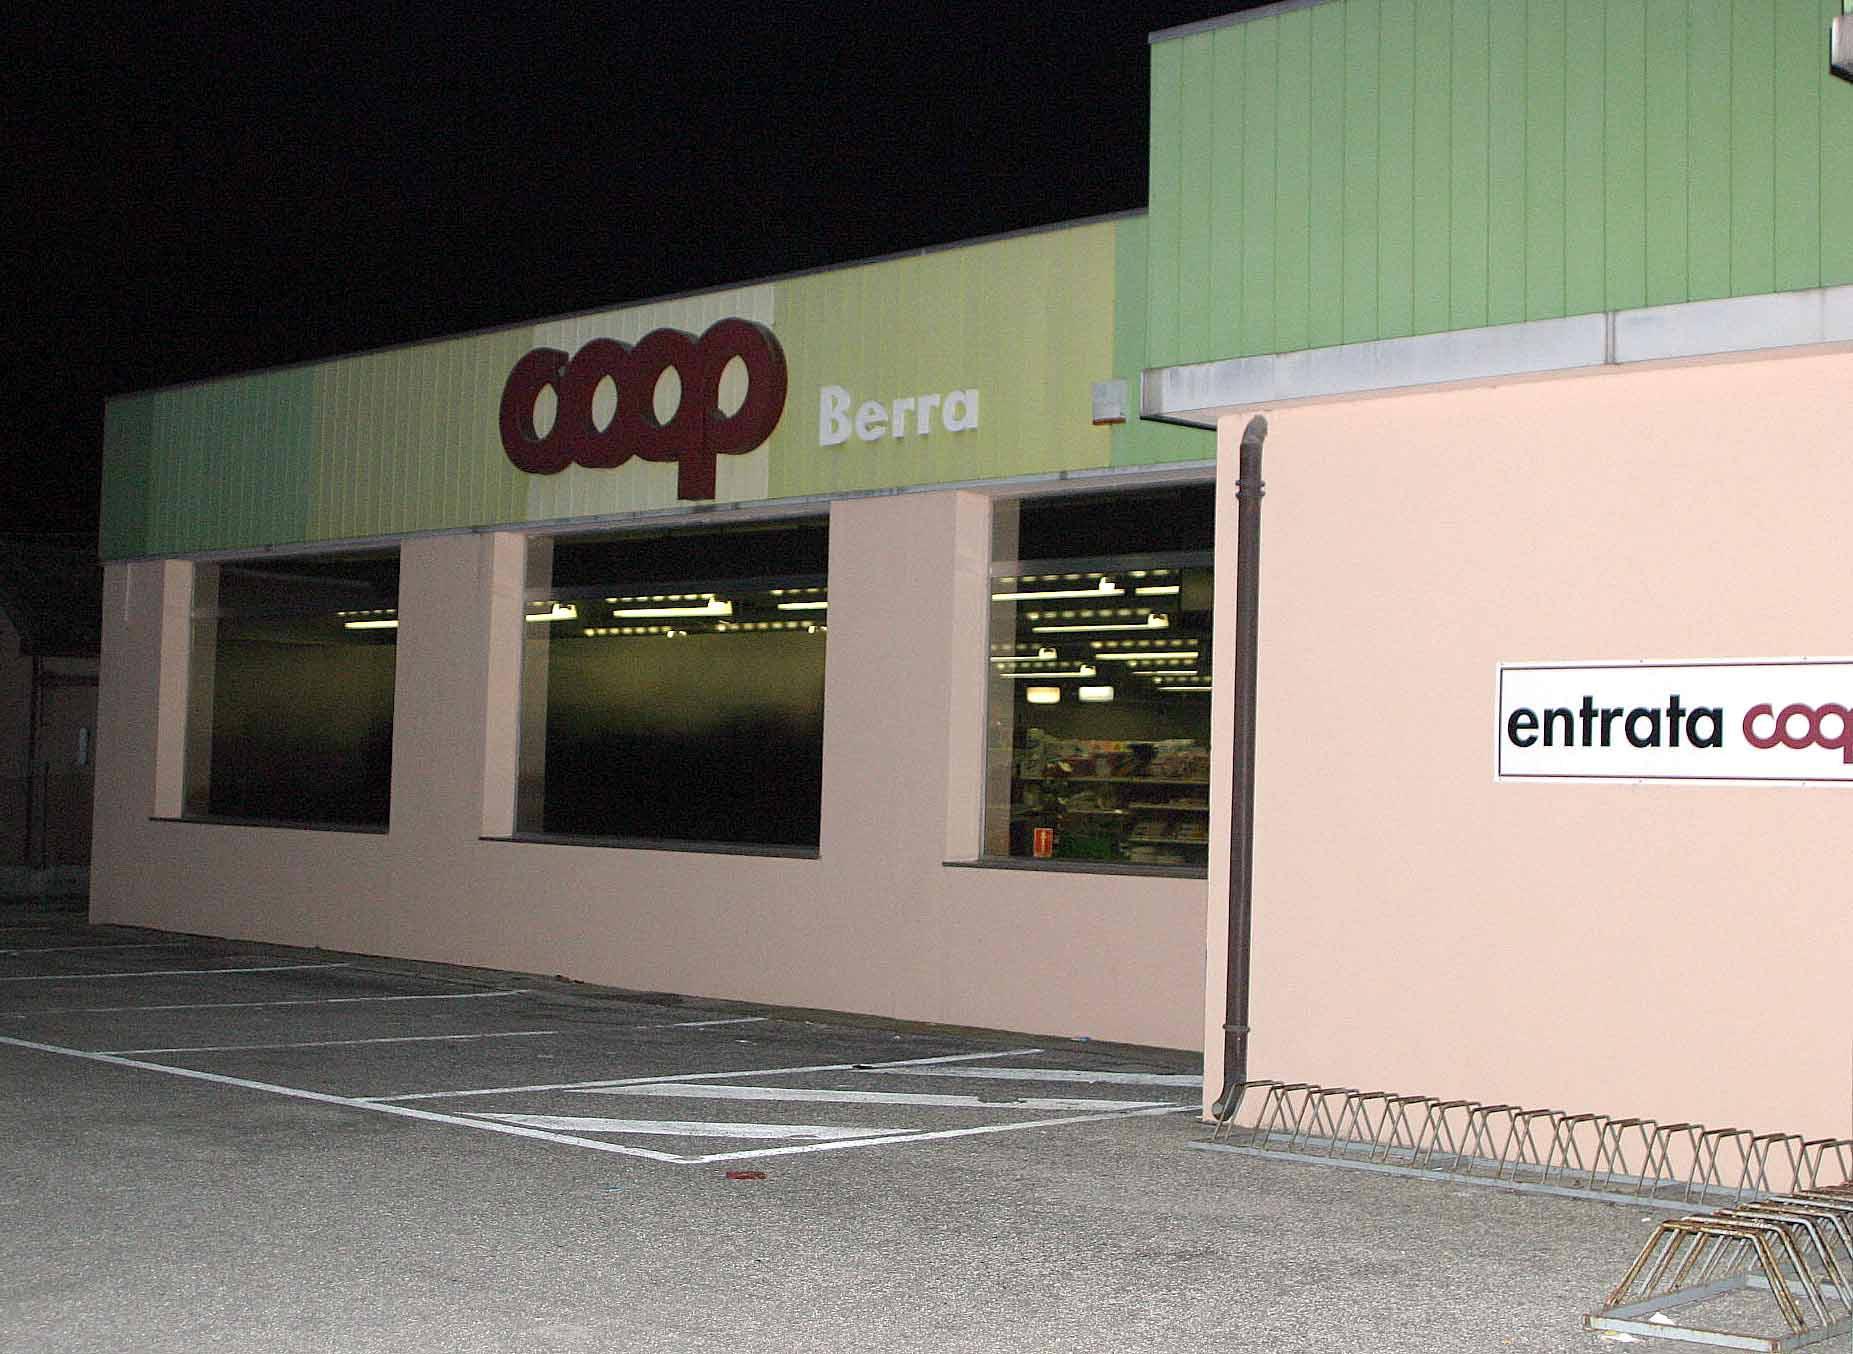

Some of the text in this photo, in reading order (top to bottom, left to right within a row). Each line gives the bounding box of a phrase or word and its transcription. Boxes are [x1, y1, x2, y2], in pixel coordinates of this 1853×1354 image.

[500, 317, 980, 501] coop Berra
[1507, 694, 1723, 748] entrata
